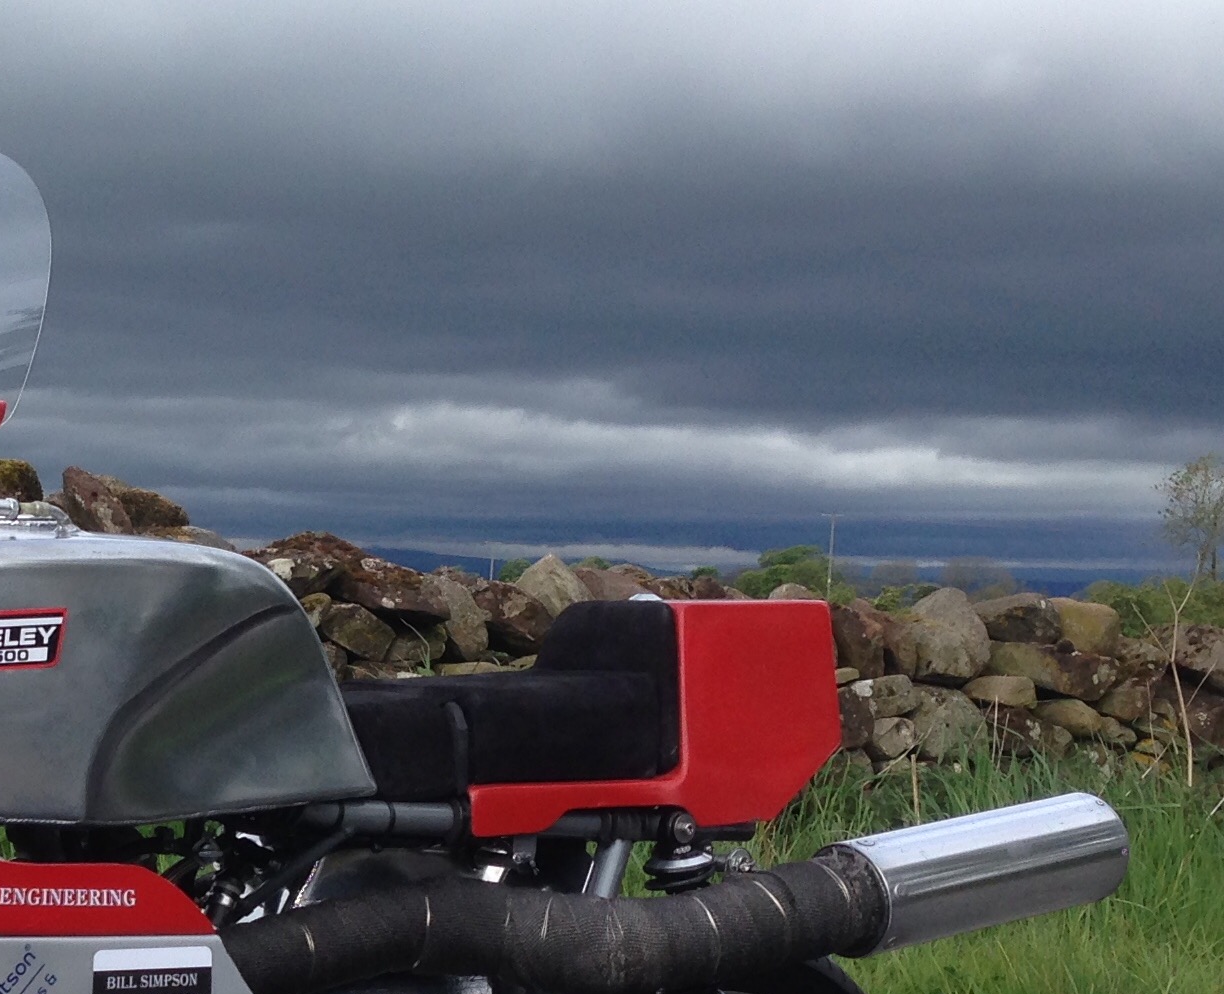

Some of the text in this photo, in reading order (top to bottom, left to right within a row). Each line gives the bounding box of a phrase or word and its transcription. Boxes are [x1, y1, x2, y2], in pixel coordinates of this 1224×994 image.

[44, 973, 58, 986] &
[106, 973, 198, 990] BILL SIMPSON
